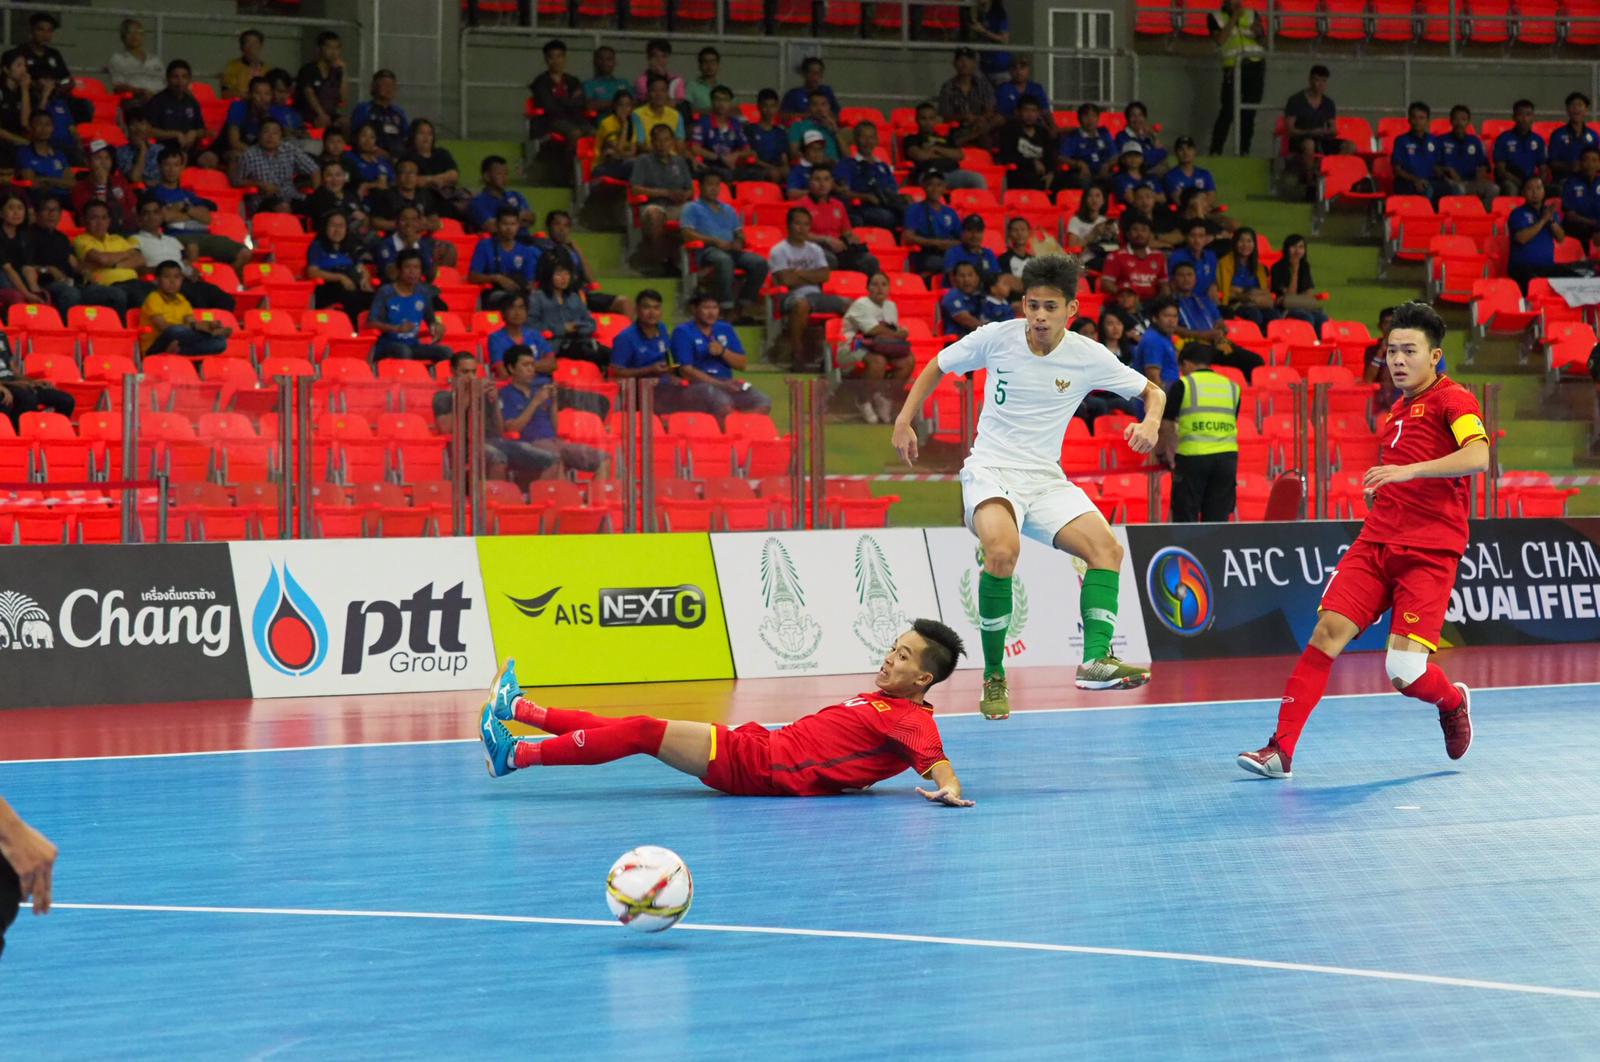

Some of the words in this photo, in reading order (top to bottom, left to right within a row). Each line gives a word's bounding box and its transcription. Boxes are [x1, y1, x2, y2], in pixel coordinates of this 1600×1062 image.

[994, 380, 1008, 406] 5
[1391, 420, 1403, 448] 7
[1223, 547, 1290, 588] AFC
[1459, 542, 1513, 580] SAL
[141, 586, 216, 601] เครื่องดื่มตราช้าง
[59, 588, 231, 657] Chang
[341, 581, 472, 675] ptt
[554, 604, 594, 626] AIS
[389, 652, 468, 676] Group
